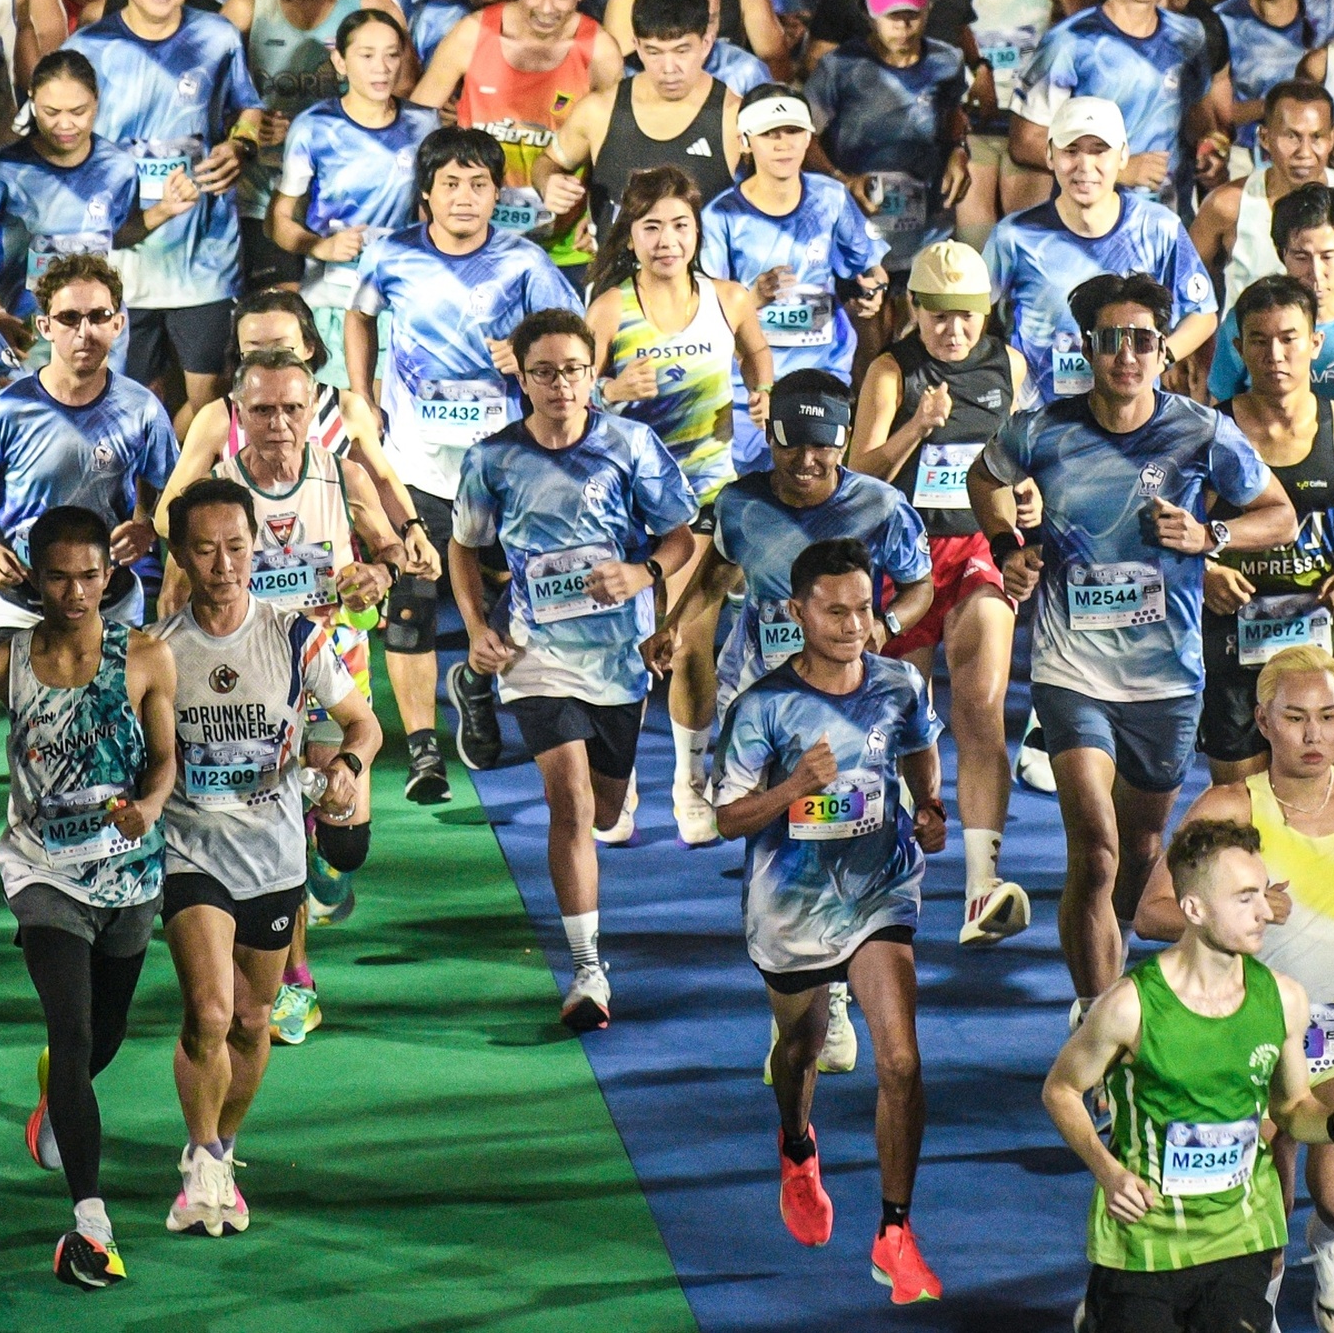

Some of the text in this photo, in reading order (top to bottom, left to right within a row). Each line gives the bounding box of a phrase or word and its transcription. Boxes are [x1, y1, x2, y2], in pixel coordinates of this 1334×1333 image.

[493, 208, 531, 224] 2289
[636, 342, 712, 360] BOSTON
[422, 404, 480, 422] M2432
[249, 570, 308, 593] M2601
[534, 575, 594, 600] M246
[1073, 588, 1138, 607] M2544
[1244, 620, 1305, 642] M2672
[188, 702, 267, 725] DRUNKER
[203, 722, 268, 743] RUNNER
[191, 767, 255, 787] M2309
[804, 799, 851, 816] 2105
[48, 811, 107, 840] M245
[1171, 1149, 1239, 1170] M2345
